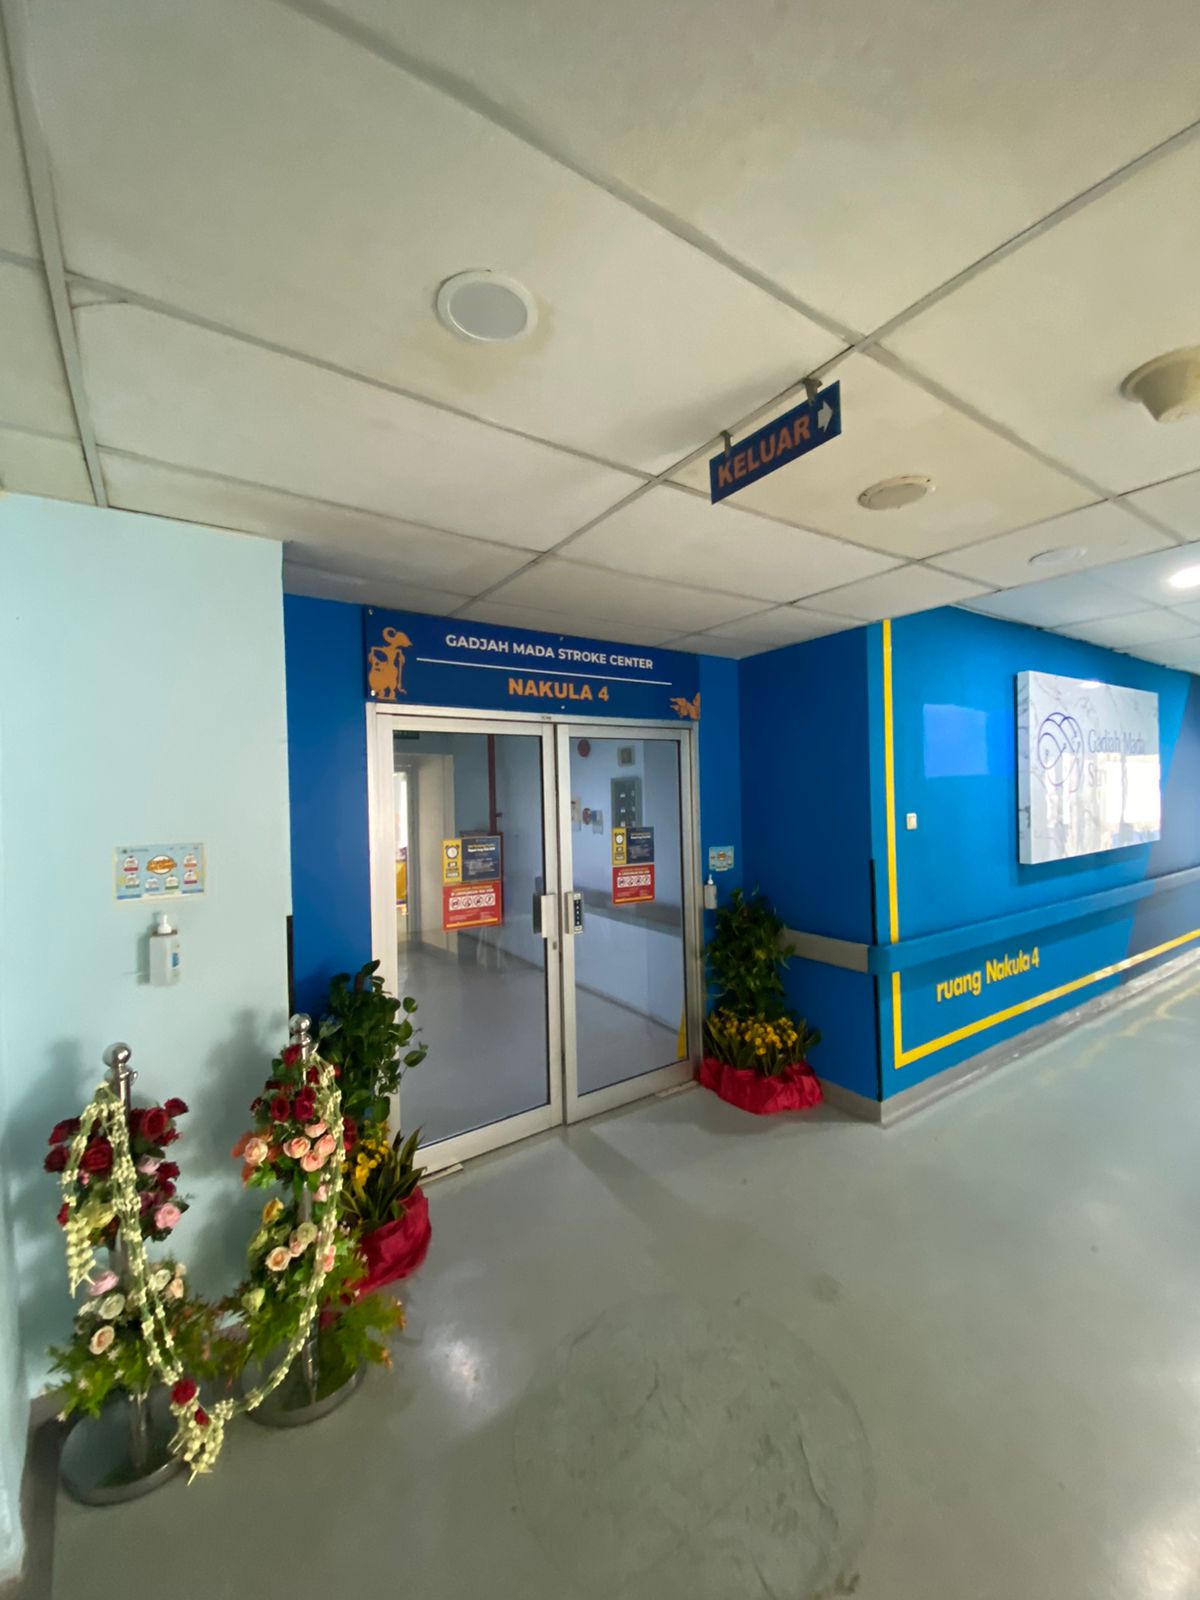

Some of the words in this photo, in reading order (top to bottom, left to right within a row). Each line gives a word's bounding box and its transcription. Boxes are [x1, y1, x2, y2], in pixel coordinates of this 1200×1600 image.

[717, 414, 811, 489] KELUAR
[445, 634, 509, 653] GADJAH
[512, 642, 556, 659] MADA
[557, 648, 607, 665] STROKE
[609, 654, 654, 670] CENTER
[508, 677, 593, 701] NAKULA
[597, 685, 609, 702] 4
[936, 970, 982, 1003] ruang
[985, 950, 1030, 984] Nakula
[1031, 946, 1040, 968] 4
